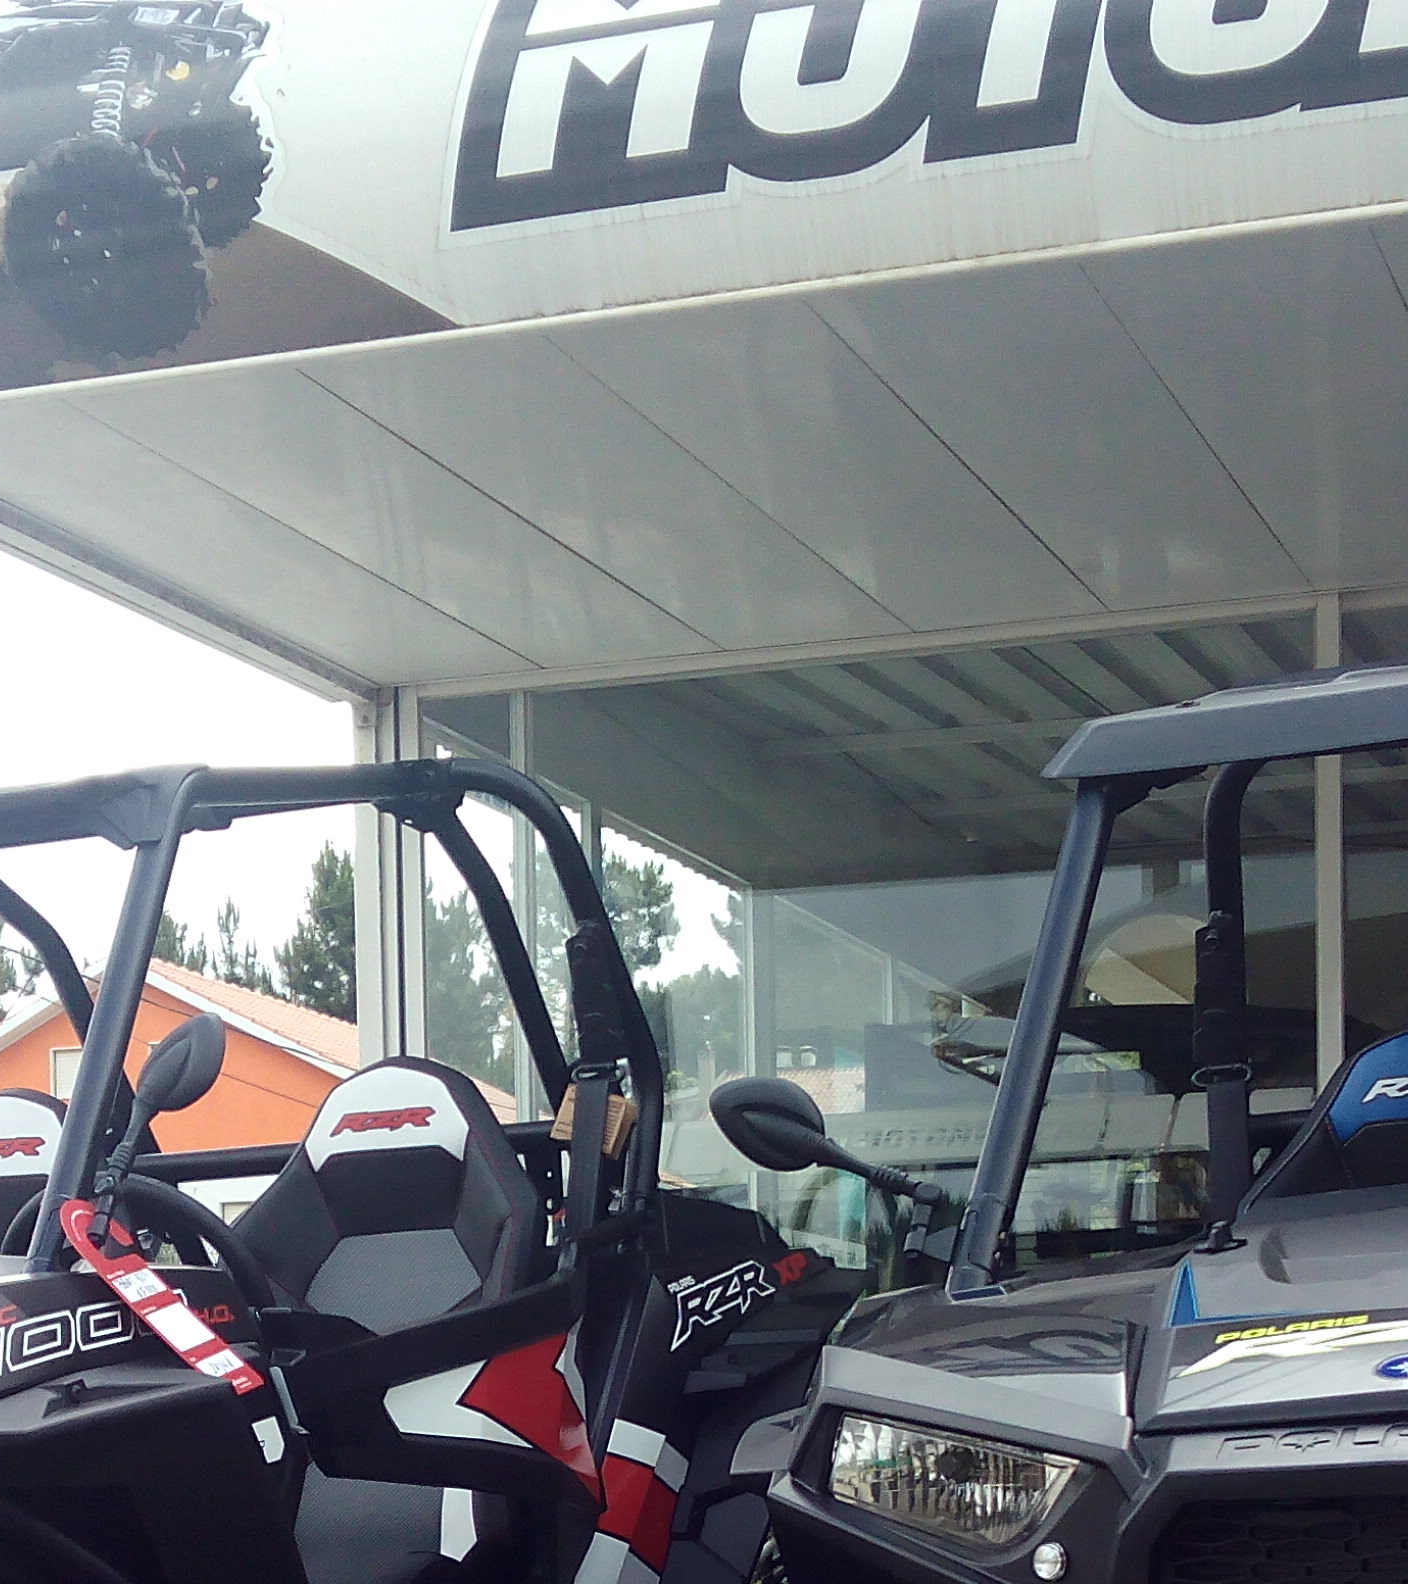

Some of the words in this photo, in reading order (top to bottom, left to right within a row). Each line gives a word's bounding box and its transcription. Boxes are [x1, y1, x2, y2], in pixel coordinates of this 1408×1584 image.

[330, 1106, 436, 1138] RZR
[667, 1275, 696, 1294] POLARIS
[671, 1260, 776, 1352] RZR
[773, 1252, 809, 1286] XP
[1215, 1315, 1369, 1343] POLARIS
